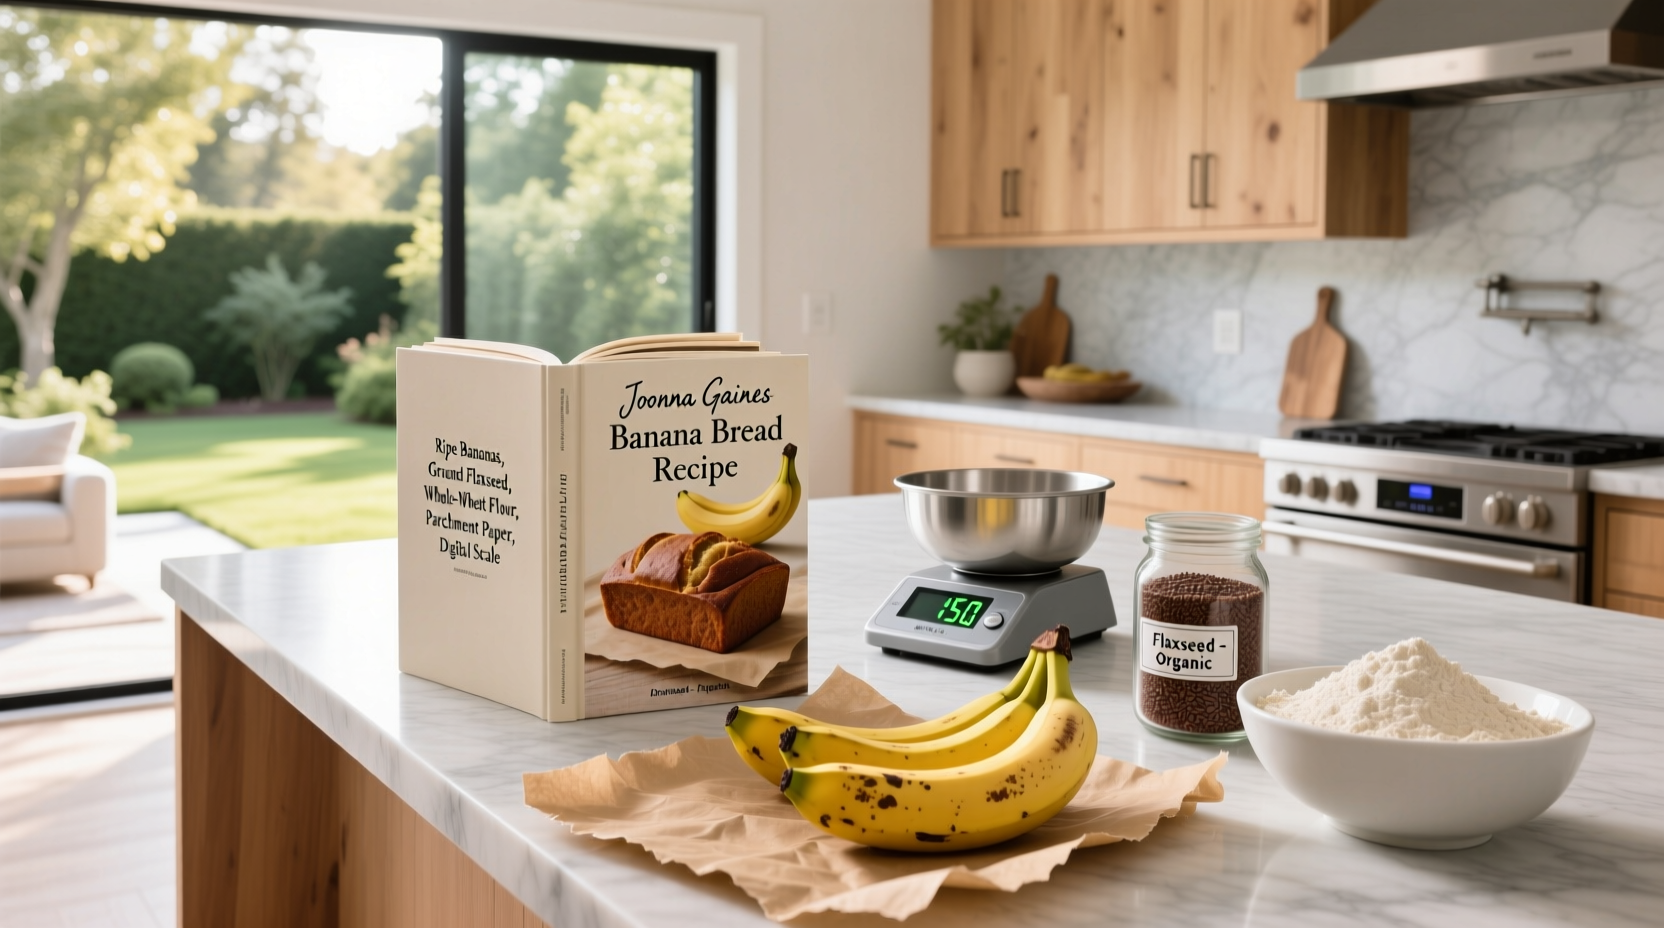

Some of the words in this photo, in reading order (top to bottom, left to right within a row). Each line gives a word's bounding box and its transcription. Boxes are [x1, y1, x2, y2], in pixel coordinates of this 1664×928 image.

[609, 424, 703, 450] Banana
[711, 414, 783, 444] Bread
[435, 437, 458, 461] Ripe
[652, 455, 738, 487] Recipe
[489, 496, 520, 521] Flour,
[426, 509, 479, 535] Parchment
[482, 520, 516, 546] Paper,
[473, 543, 501, 565] Scale
[937, 597, 983, 627] 150
[1153, 632, 1215, 652] Flaxseed
[1156, 652, 1212, 672] Organic
